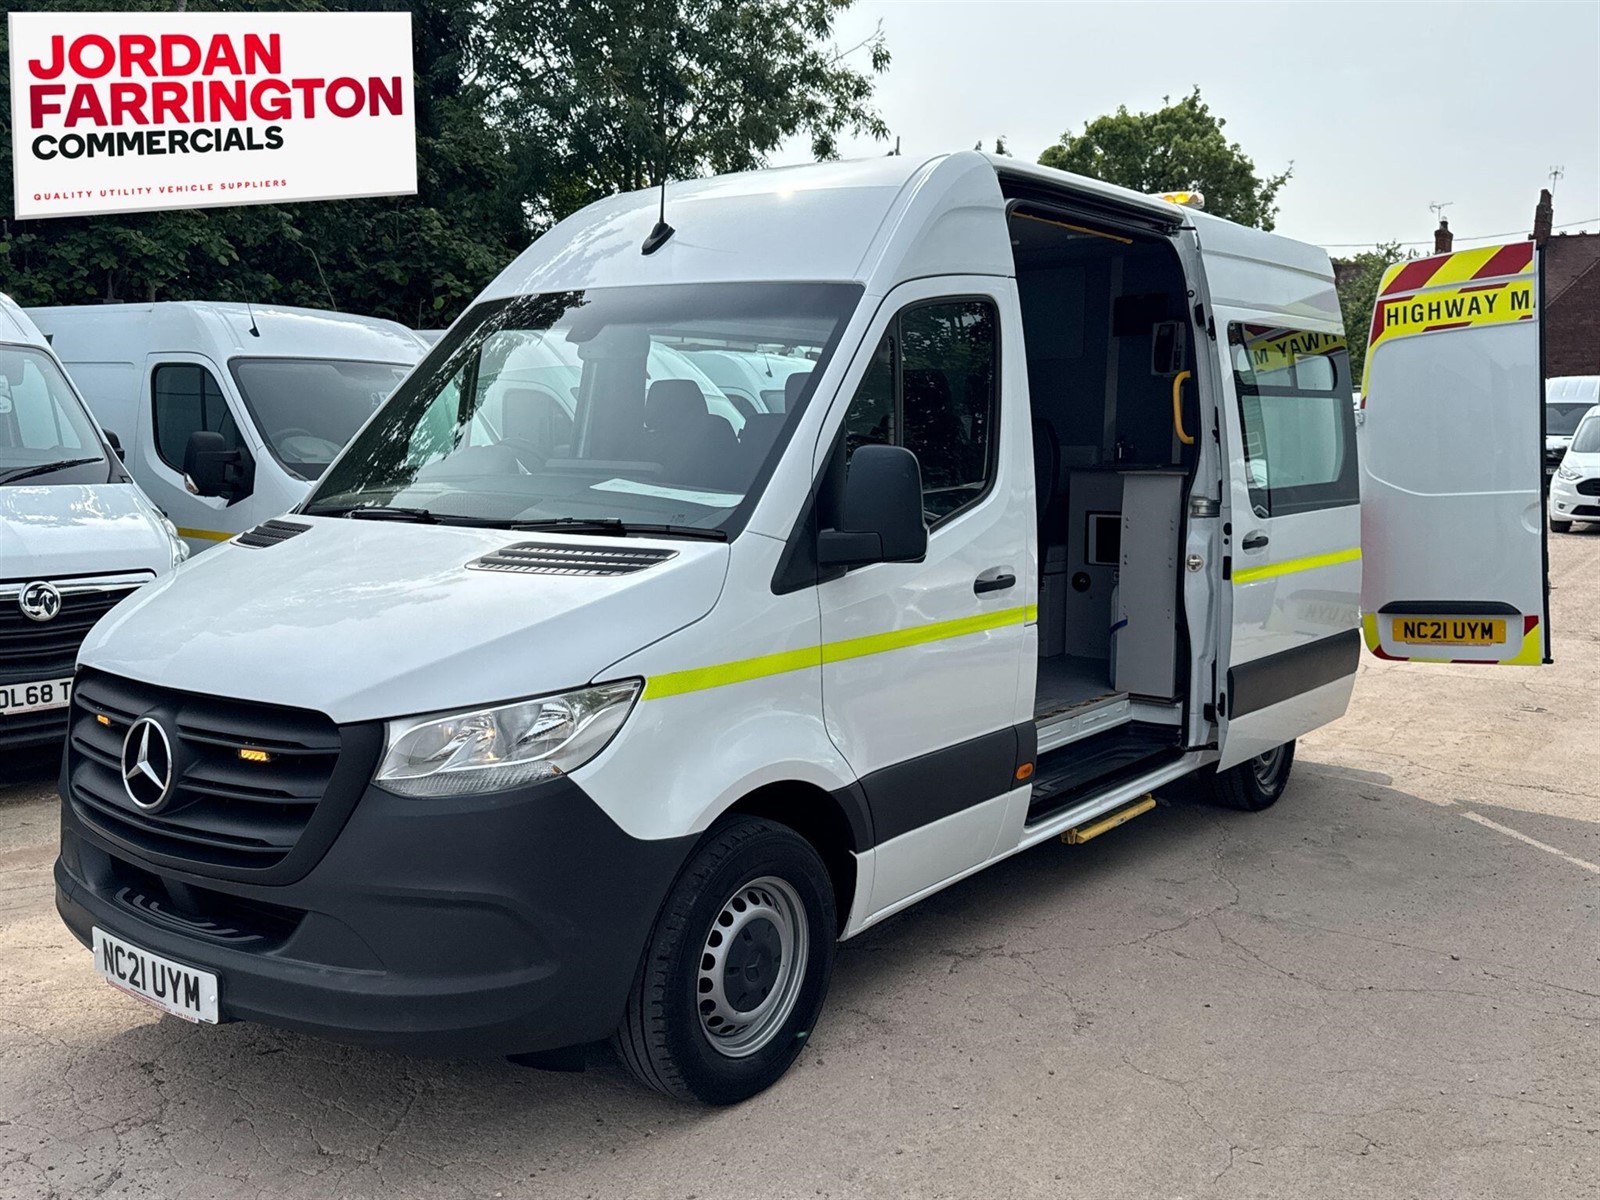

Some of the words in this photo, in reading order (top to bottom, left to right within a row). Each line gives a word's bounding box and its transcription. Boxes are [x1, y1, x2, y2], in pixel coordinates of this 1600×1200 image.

[1386, 293, 1498, 327] HIGHWAY
[1511, 290, 1536, 310] M
[1404, 621, 1447, 639] NC21
[1453, 622, 1493, 640] UYM
[59, 681, 71, 700] T
[102, 938, 147, 991] NC21
[151, 961, 200, 1012] UYM
